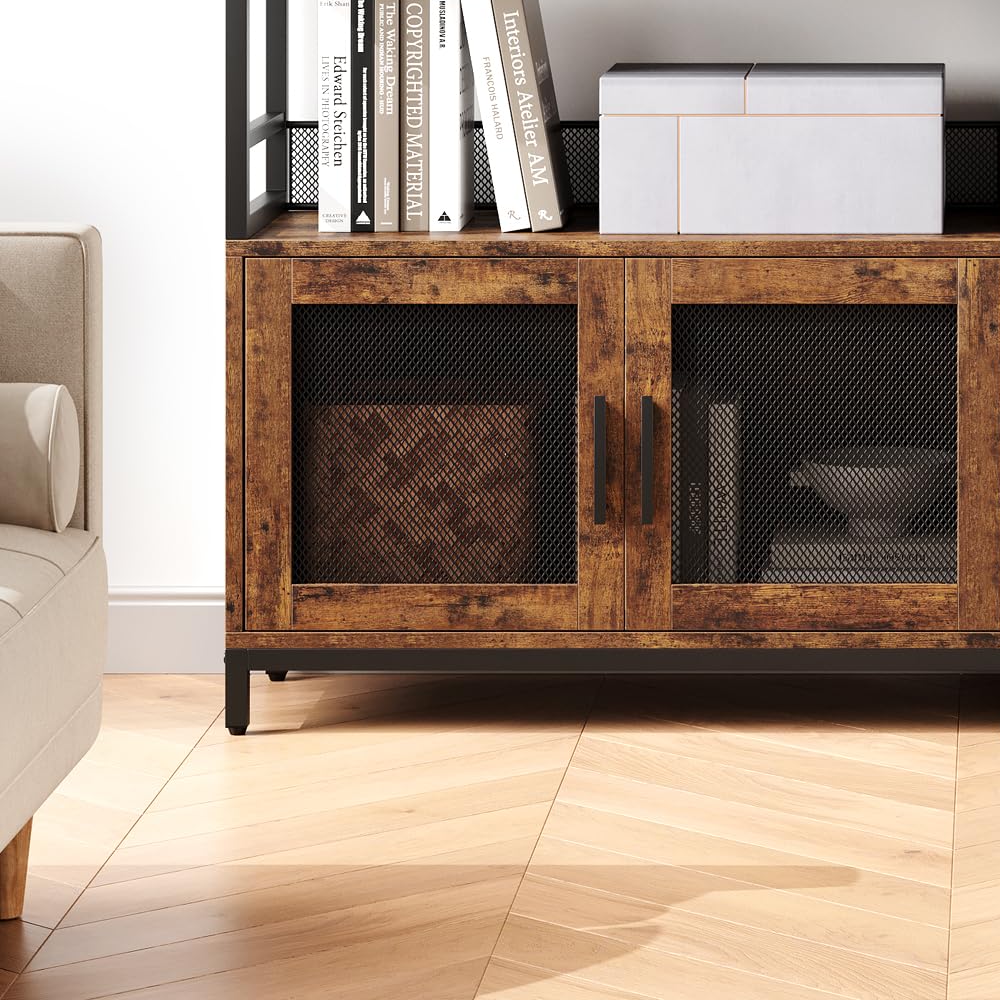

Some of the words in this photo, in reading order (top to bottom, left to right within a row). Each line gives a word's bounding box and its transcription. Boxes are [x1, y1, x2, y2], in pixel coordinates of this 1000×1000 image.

[386, 3, 396, 27] The
[321, 56, 329, 81] LIVES
[384, 30, 396, 73] Waking
[405, 3, 423, 128] COPYRIGHTED
[321, 85, 329, 95] IN
[333, 56, 347, 106] Edward
[386, 77, 396, 115] Dream
[482, 56, 497, 101] FRANCOIS
[491, 104, 504, 140] HALARD
[503, 10, 527, 86] Interiors
[516, 90, 539, 147] Atelier
[528, 152, 549, 186] AM
[333, 111, 347, 167] Steichen
[405, 133, 423, 220] MATERIAL
